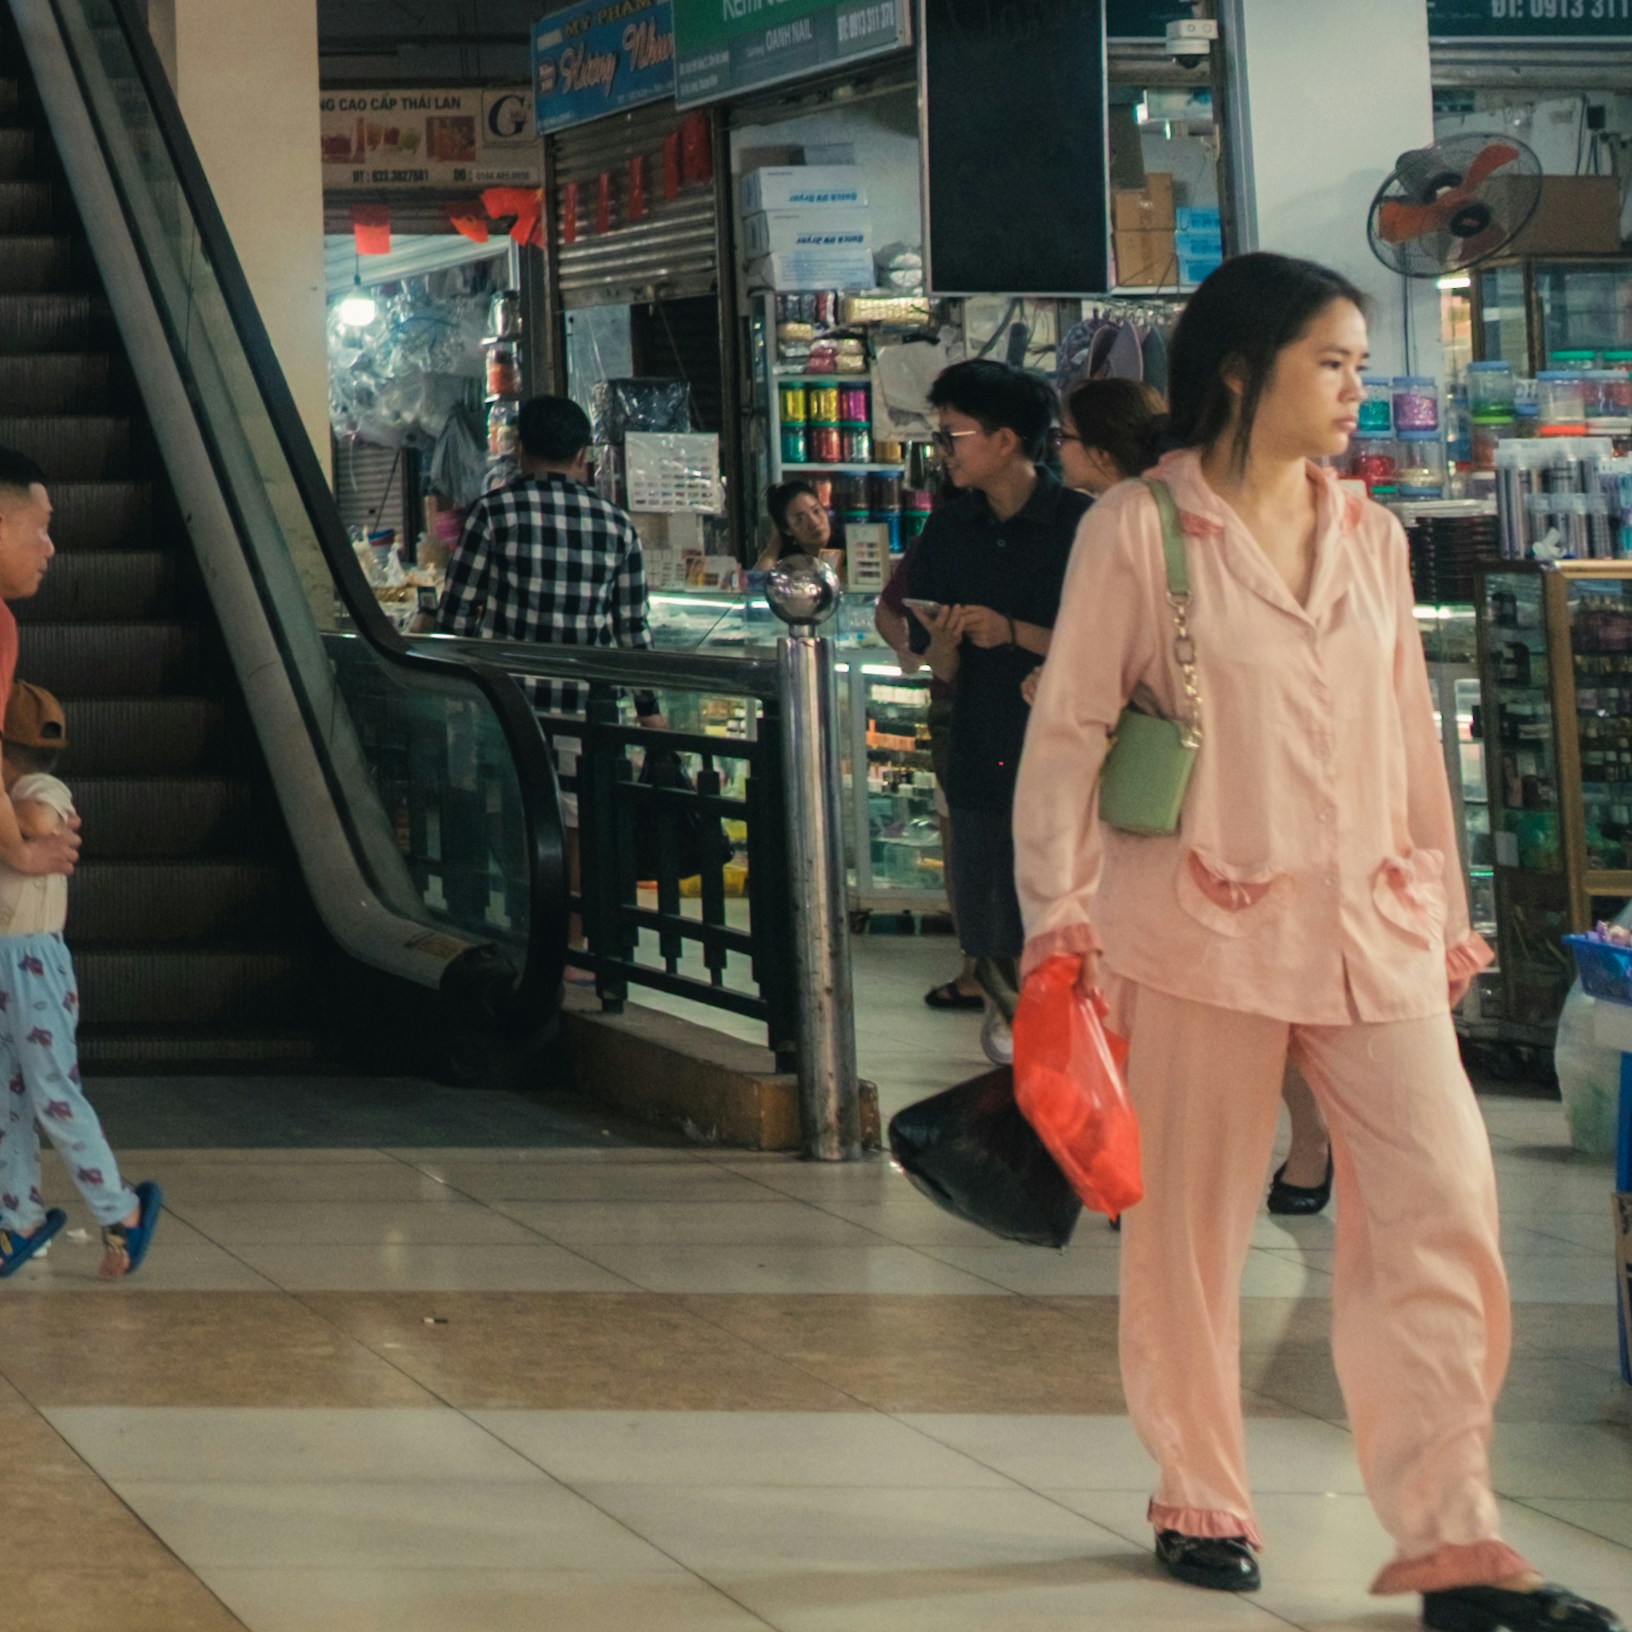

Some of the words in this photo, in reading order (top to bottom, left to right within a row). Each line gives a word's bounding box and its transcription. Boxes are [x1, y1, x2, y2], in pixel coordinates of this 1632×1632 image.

[338, 98, 367, 111] CAO
[371, 92, 398, 110] CẤP
[401, 94, 431, 110] THÁI
[434, 97, 461, 110] LAN
